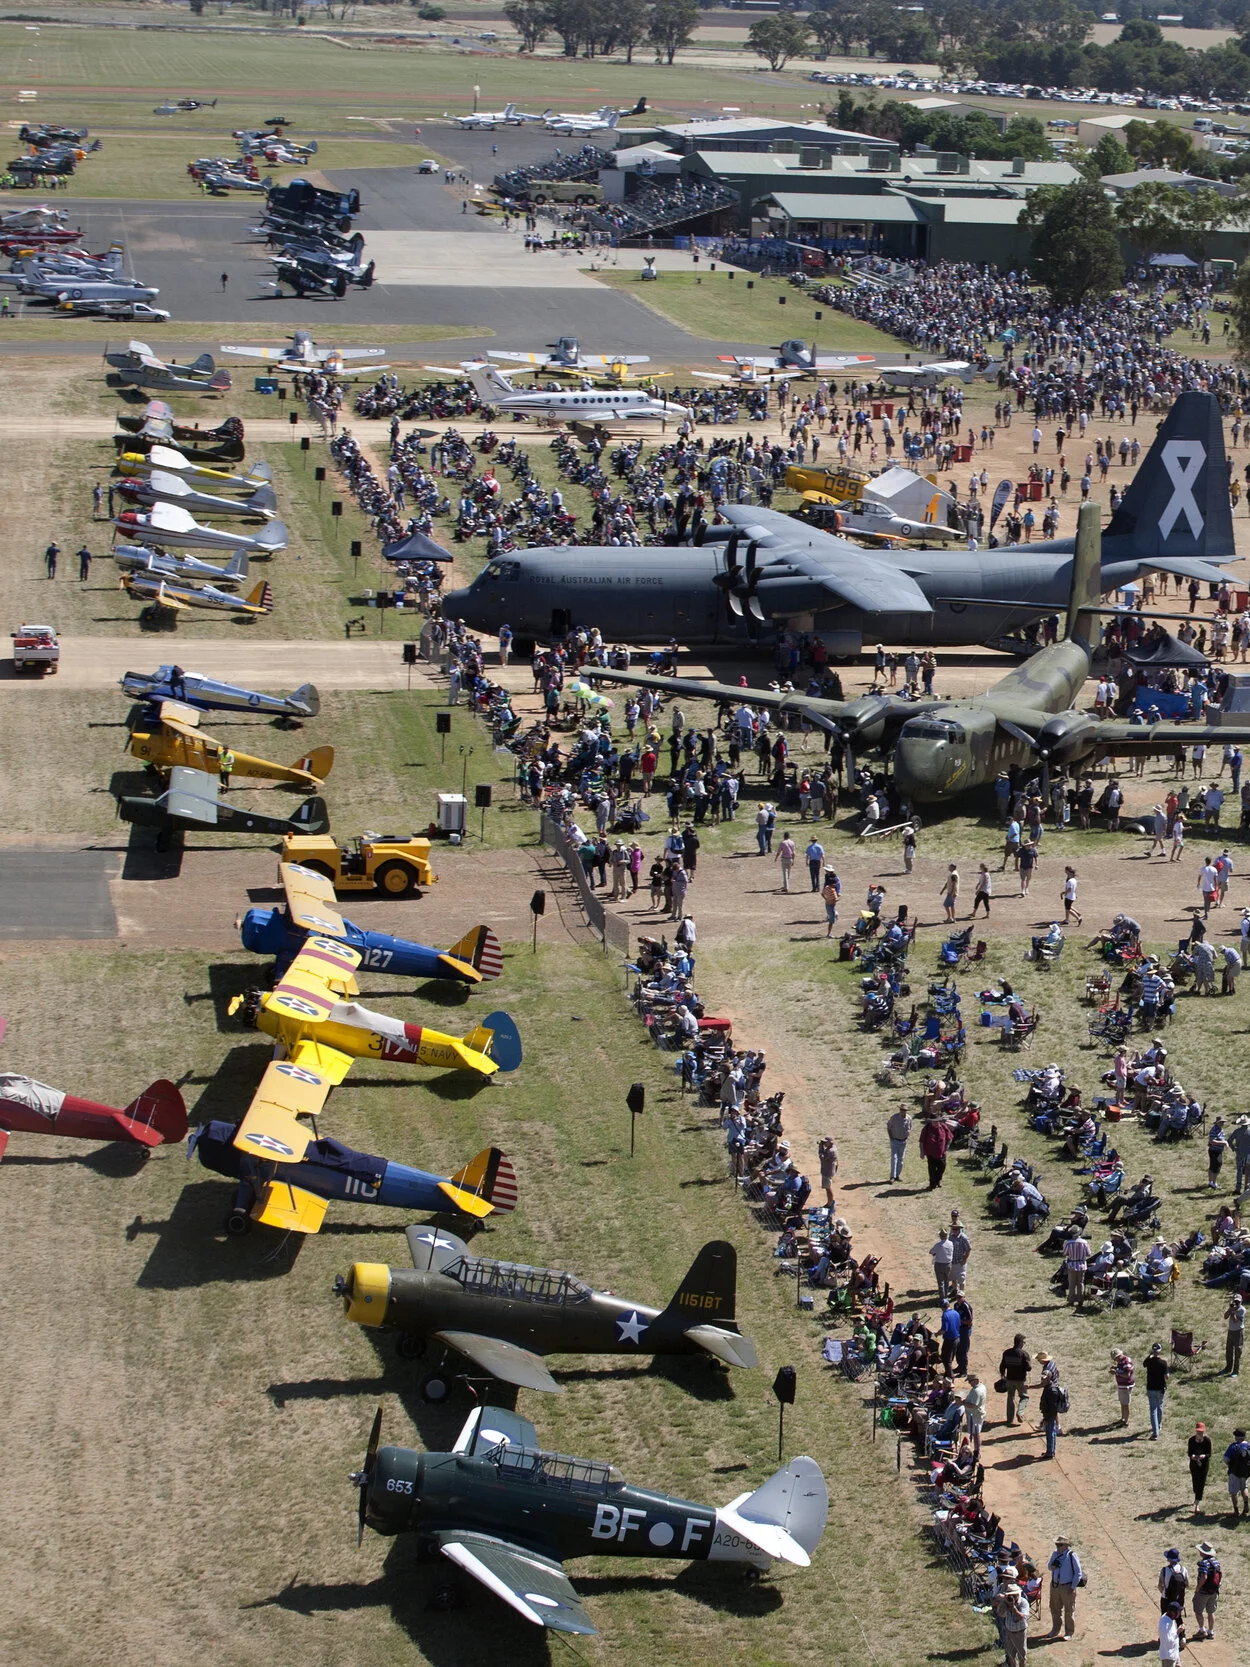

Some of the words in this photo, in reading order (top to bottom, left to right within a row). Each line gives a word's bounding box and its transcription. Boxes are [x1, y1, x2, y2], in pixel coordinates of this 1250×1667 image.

[824, 475, 860, 496] 099
[529, 576, 555, 584] ROYAL
[561, 576, 613, 584] AUSTRALIAN
[616, 576, 631, 585] AIR
[635, 577, 664, 585] FORCE
[363, 948, 393, 968] 127
[431, 1048, 459, 1061] NAVY
[386, 1478, 414, 1495] 653
[591, 1502, 647, 1543] BF
[681, 1517, 711, 1552] F
